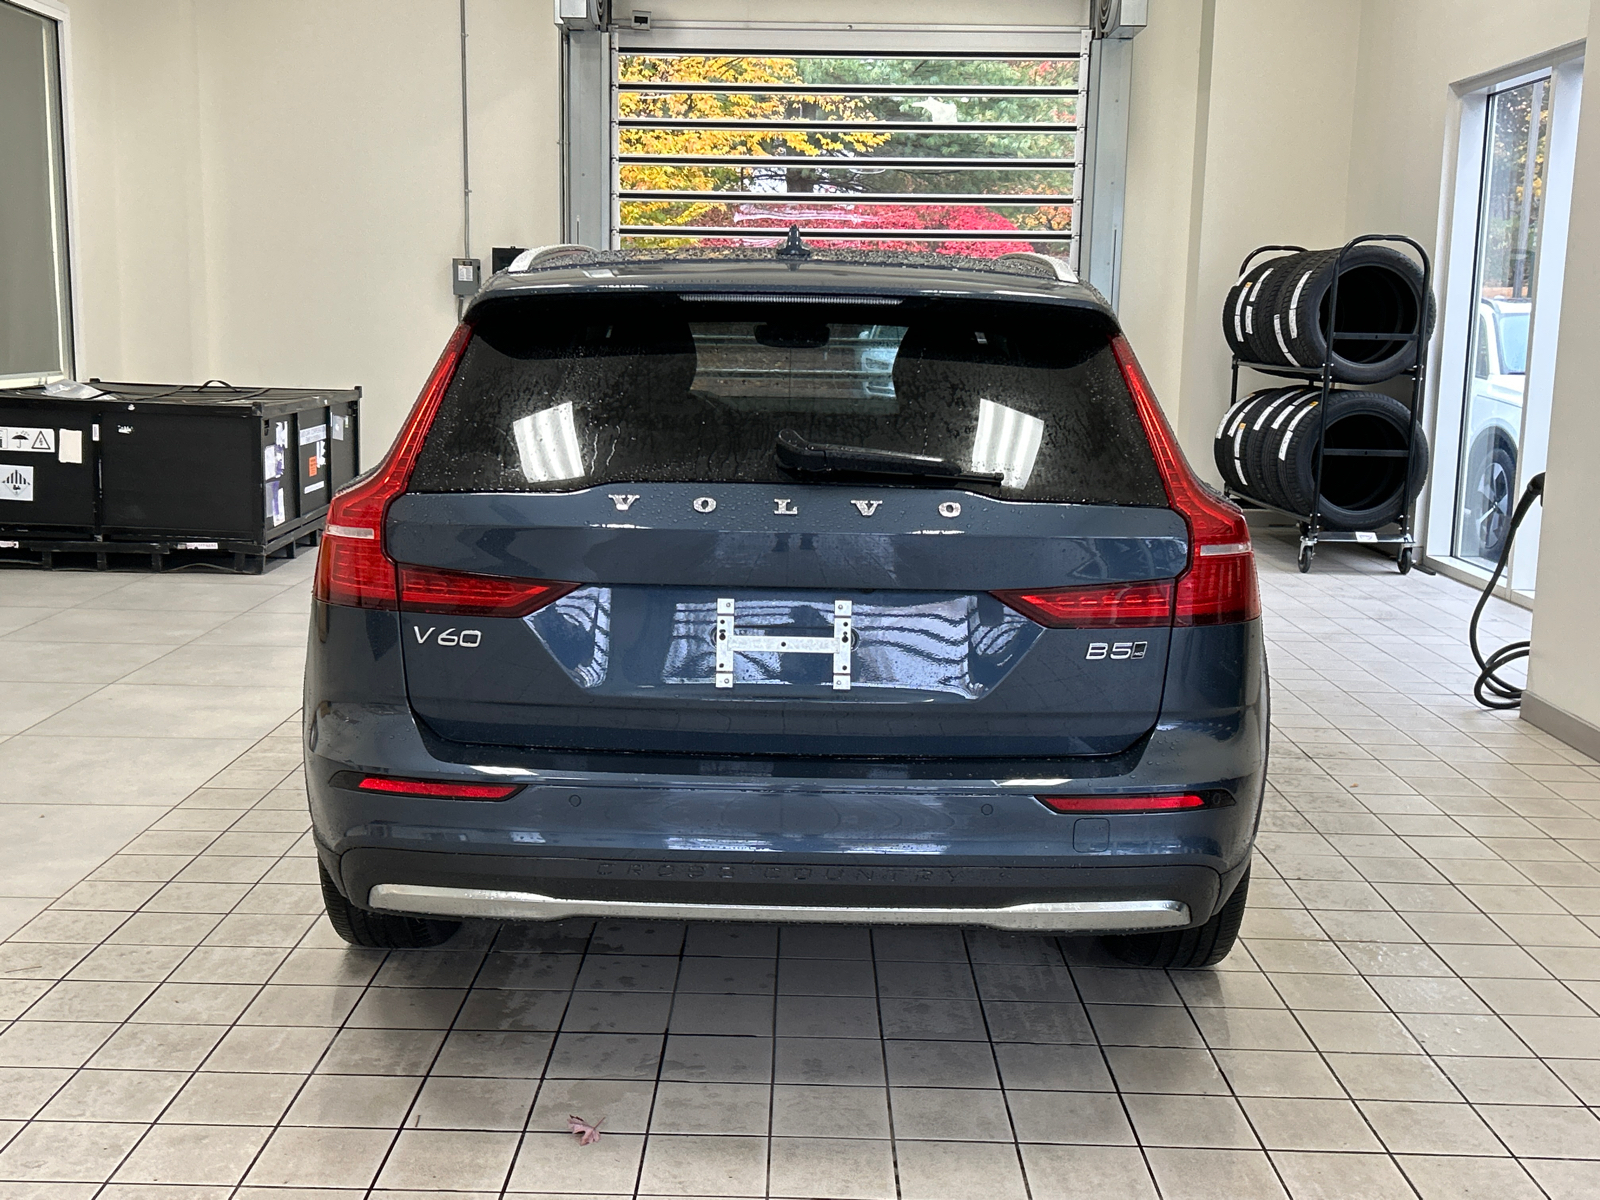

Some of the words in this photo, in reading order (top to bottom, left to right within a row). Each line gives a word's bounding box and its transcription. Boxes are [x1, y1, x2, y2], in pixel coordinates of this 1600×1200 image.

[608, 493, 962, 518] VOLVO
[413, 625, 482, 648] V60
[1085, 642, 1133, 660] B5
[596, 862, 736, 880] CROSS
[763, 866, 965, 884] COUNTRY
